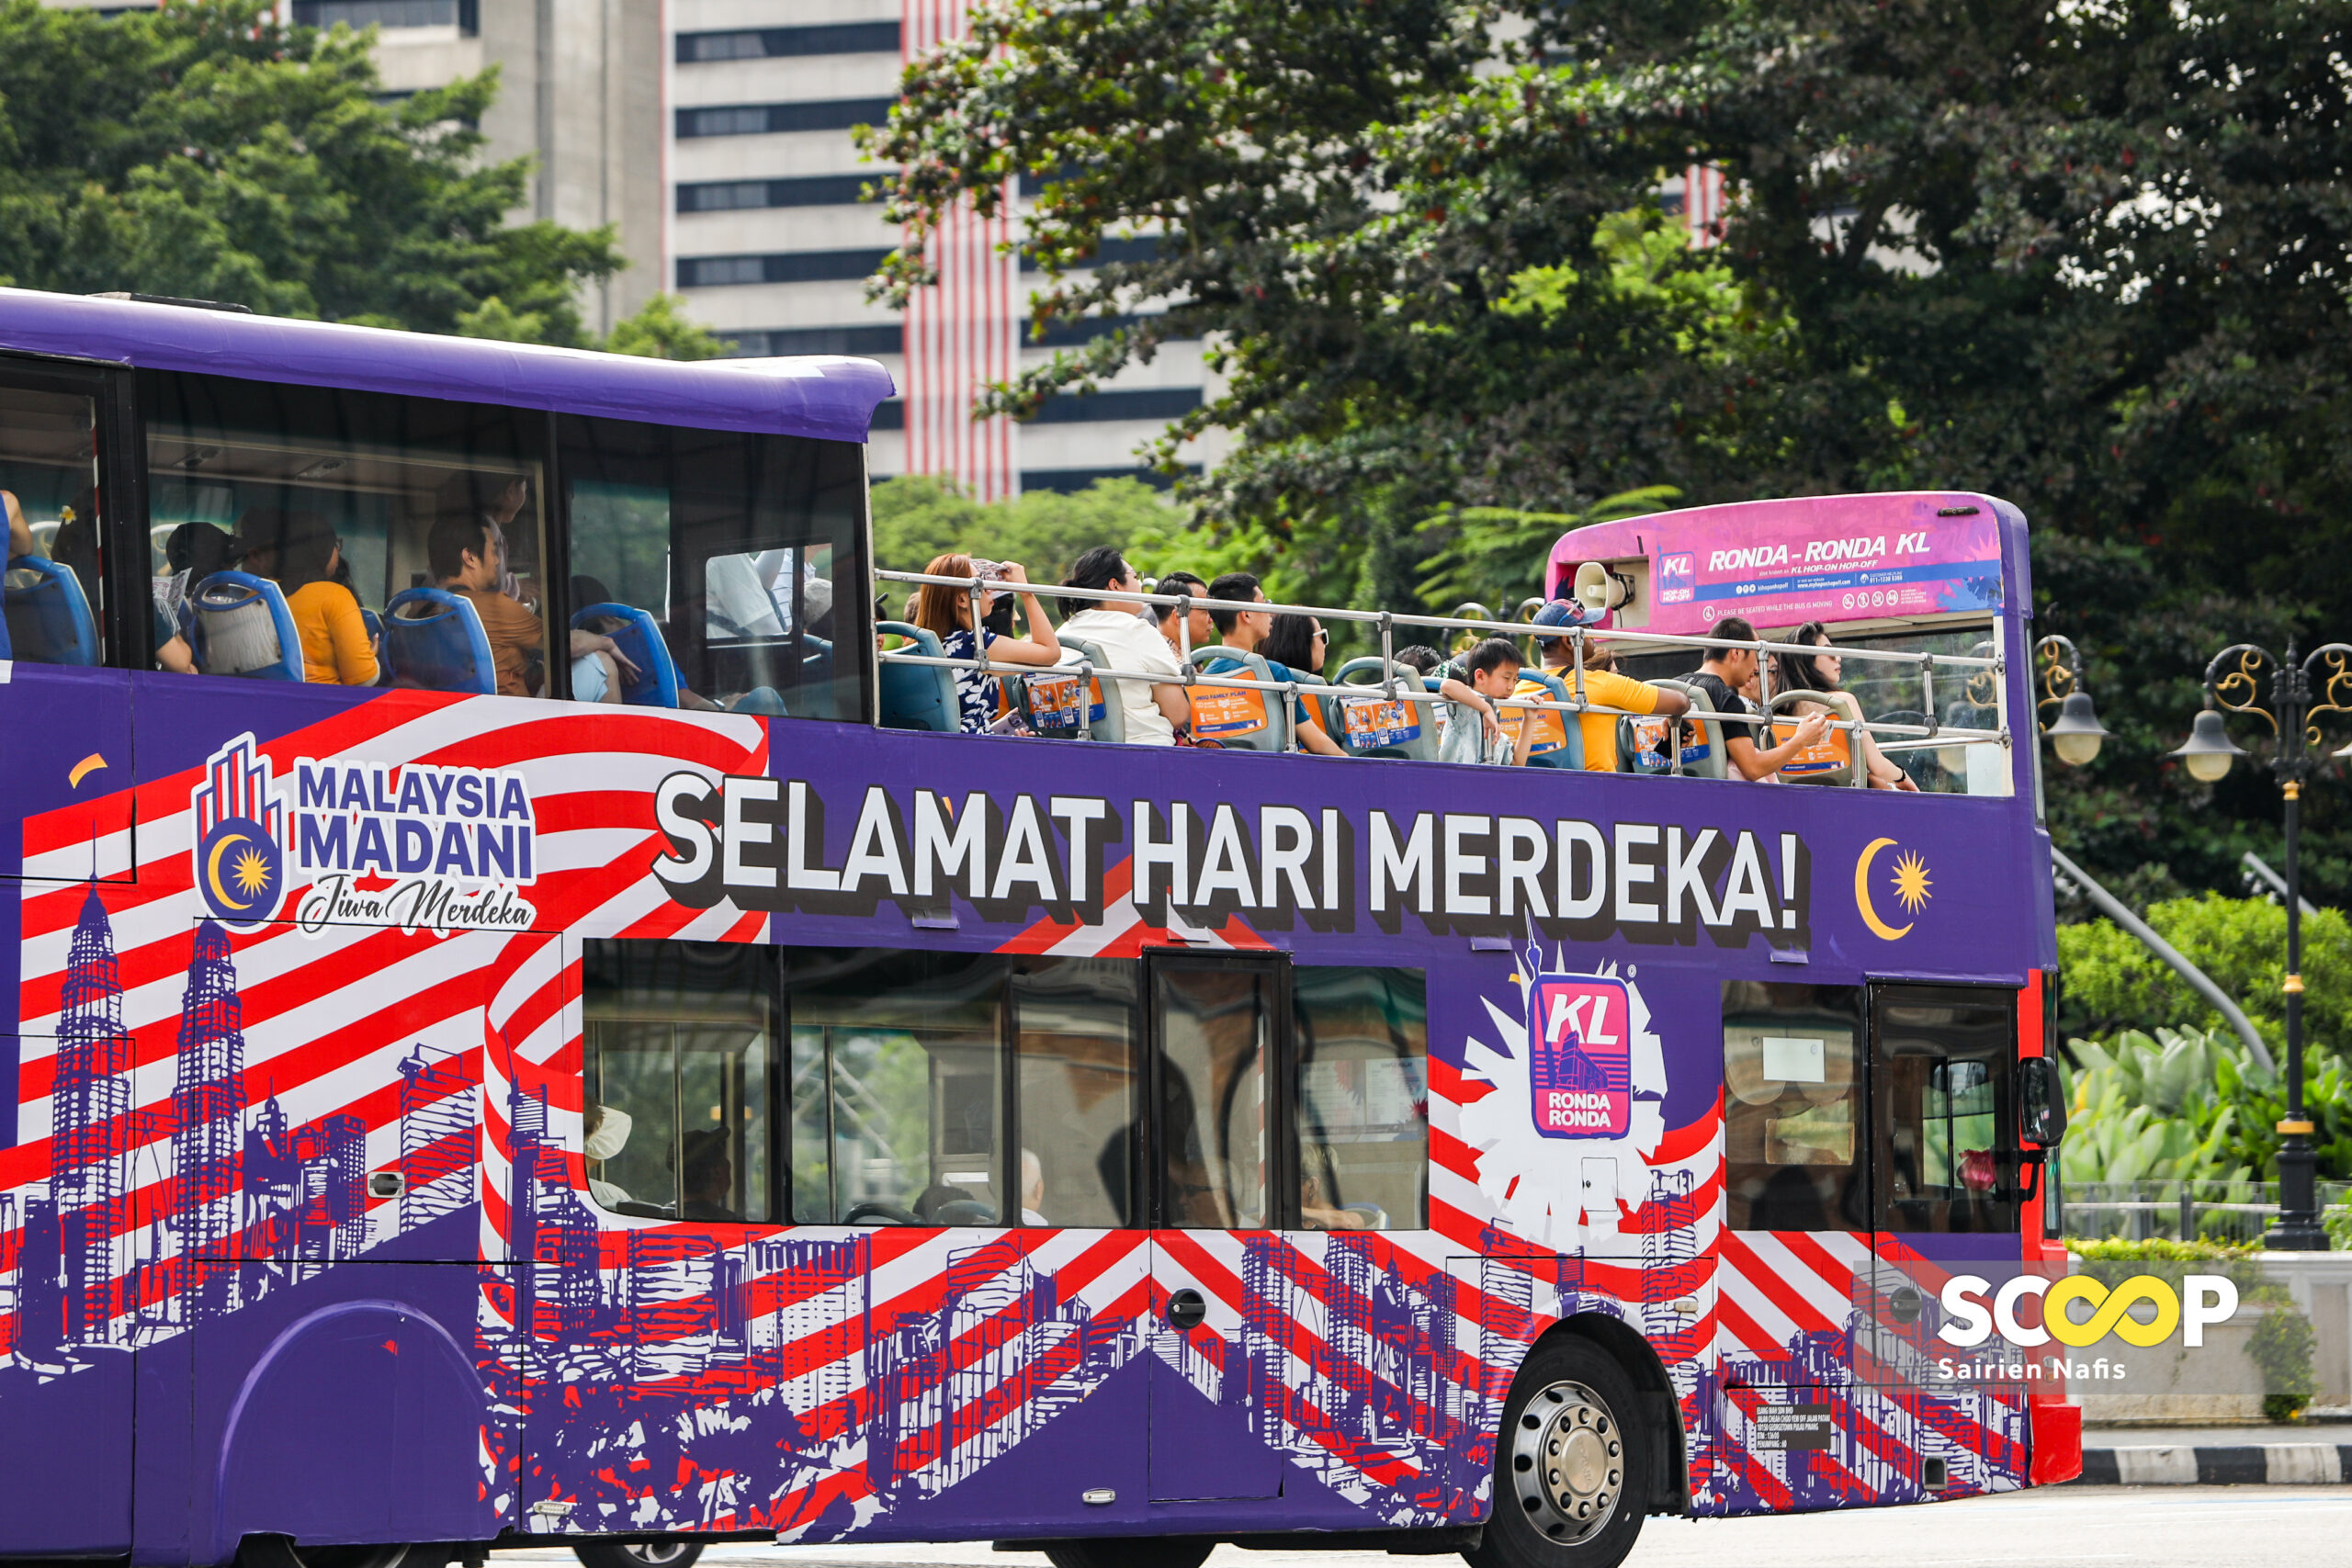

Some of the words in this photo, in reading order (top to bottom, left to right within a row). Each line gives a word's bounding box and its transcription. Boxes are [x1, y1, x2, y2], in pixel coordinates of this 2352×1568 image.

[1894, 532, 1930, 554] KL
[1663, 557, 1690, 576] KL
[1804, 562, 1838, 573] HOP-ON
[1839, 559, 1878, 570] HOP-OFF
[1663, 589, 1690, 597] HOP-ON
[298, 764, 530, 820] MALAYSIA
[300, 813, 531, 879] MADANI
[651, 772, 1106, 903] SELAMAT
[1132, 800, 1338, 909] HARI
[1370, 810, 1796, 930] MERDEKA!
[301, 874, 390, 932] Jiwa
[384, 878, 531, 931] Merdeka
[1545, 993, 1619, 1045] KL
[1549, 1092, 1611, 1111] RONDA
[1549, 1109, 1611, 1127] RONDA
[1757, 1415, 1768, 1423] JALAN
[1769, 1423, 1792, 1431] GEORGETOWN
[1805, 1422, 1818, 1430] PINANG
